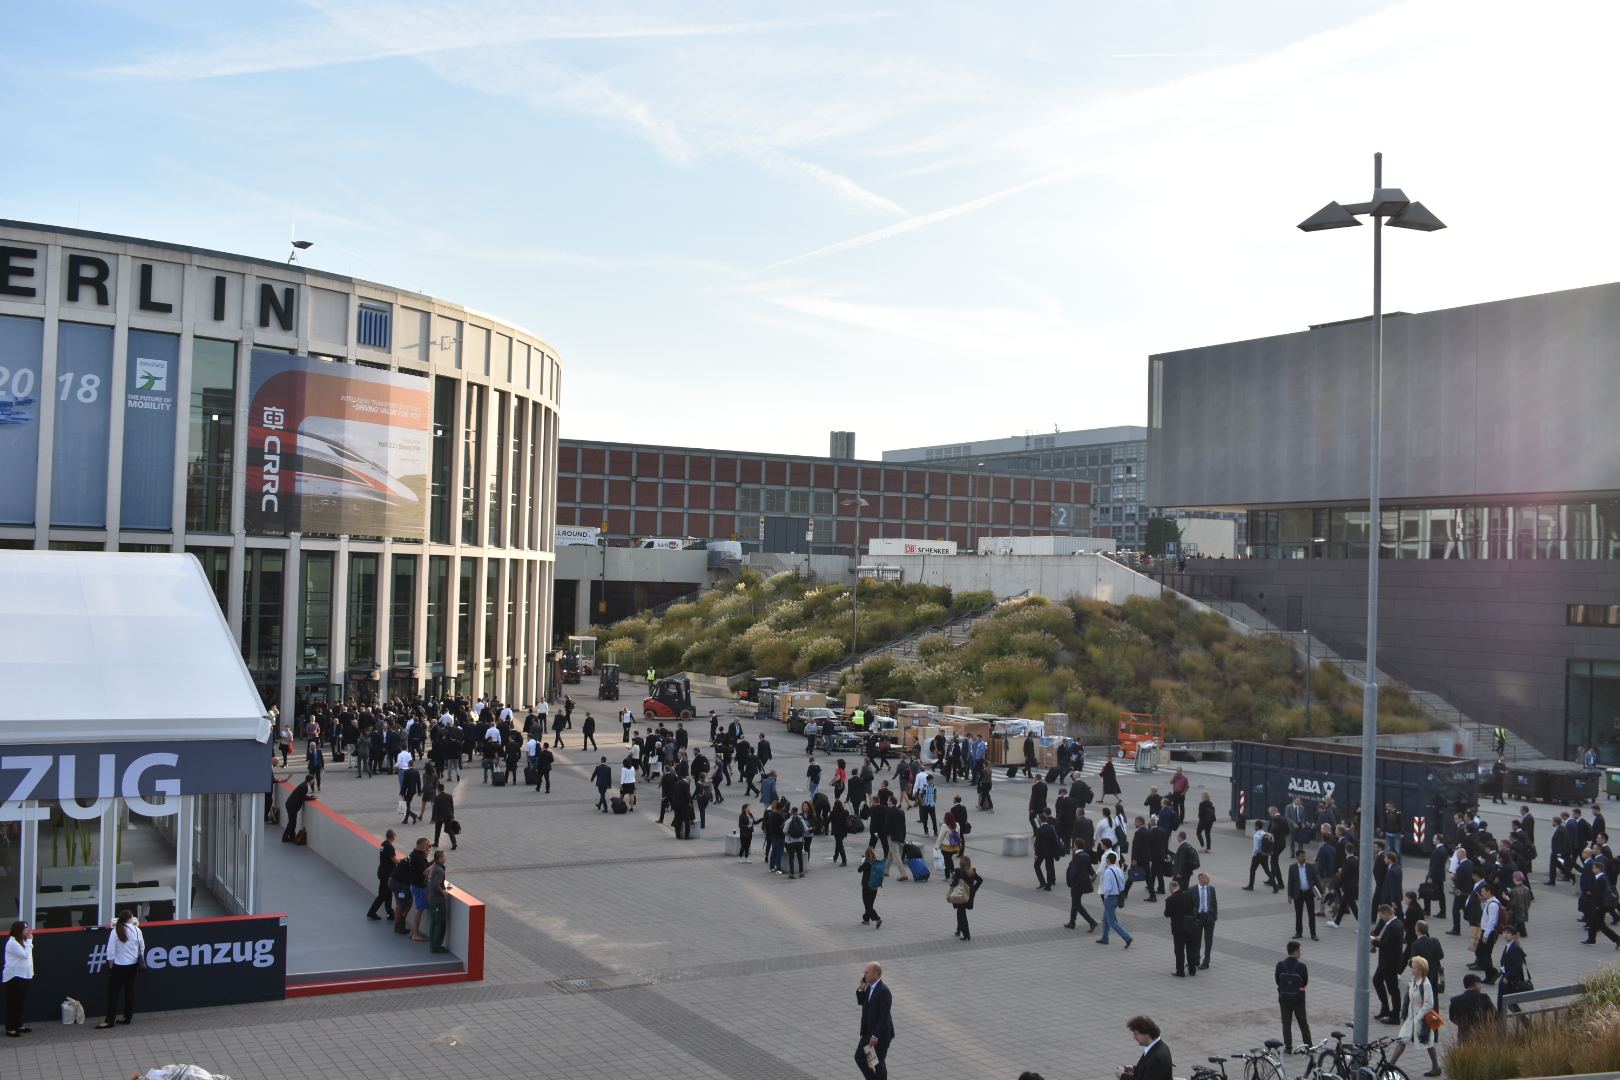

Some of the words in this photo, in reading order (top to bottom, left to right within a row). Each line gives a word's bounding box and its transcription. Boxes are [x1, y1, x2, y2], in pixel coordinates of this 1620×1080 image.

[128, 400, 172, 410] MOBILITY
[341, 395, 371, 404] INTELLIGENT
[372, 399, 398, 408] TRANSPORT
[380, 407, 398, 416] VALUE
[398, 410, 409, 418] FOR
[262, 435, 281, 513] CRRC
[1058, 507, 1068, 526] 2
[555, 530, 588, 538] LROUND
[0, 752, 181, 822] ZUG
[1288, 777, 1321, 794] ALBA
[87, 939, 275, 974] #eenzug
